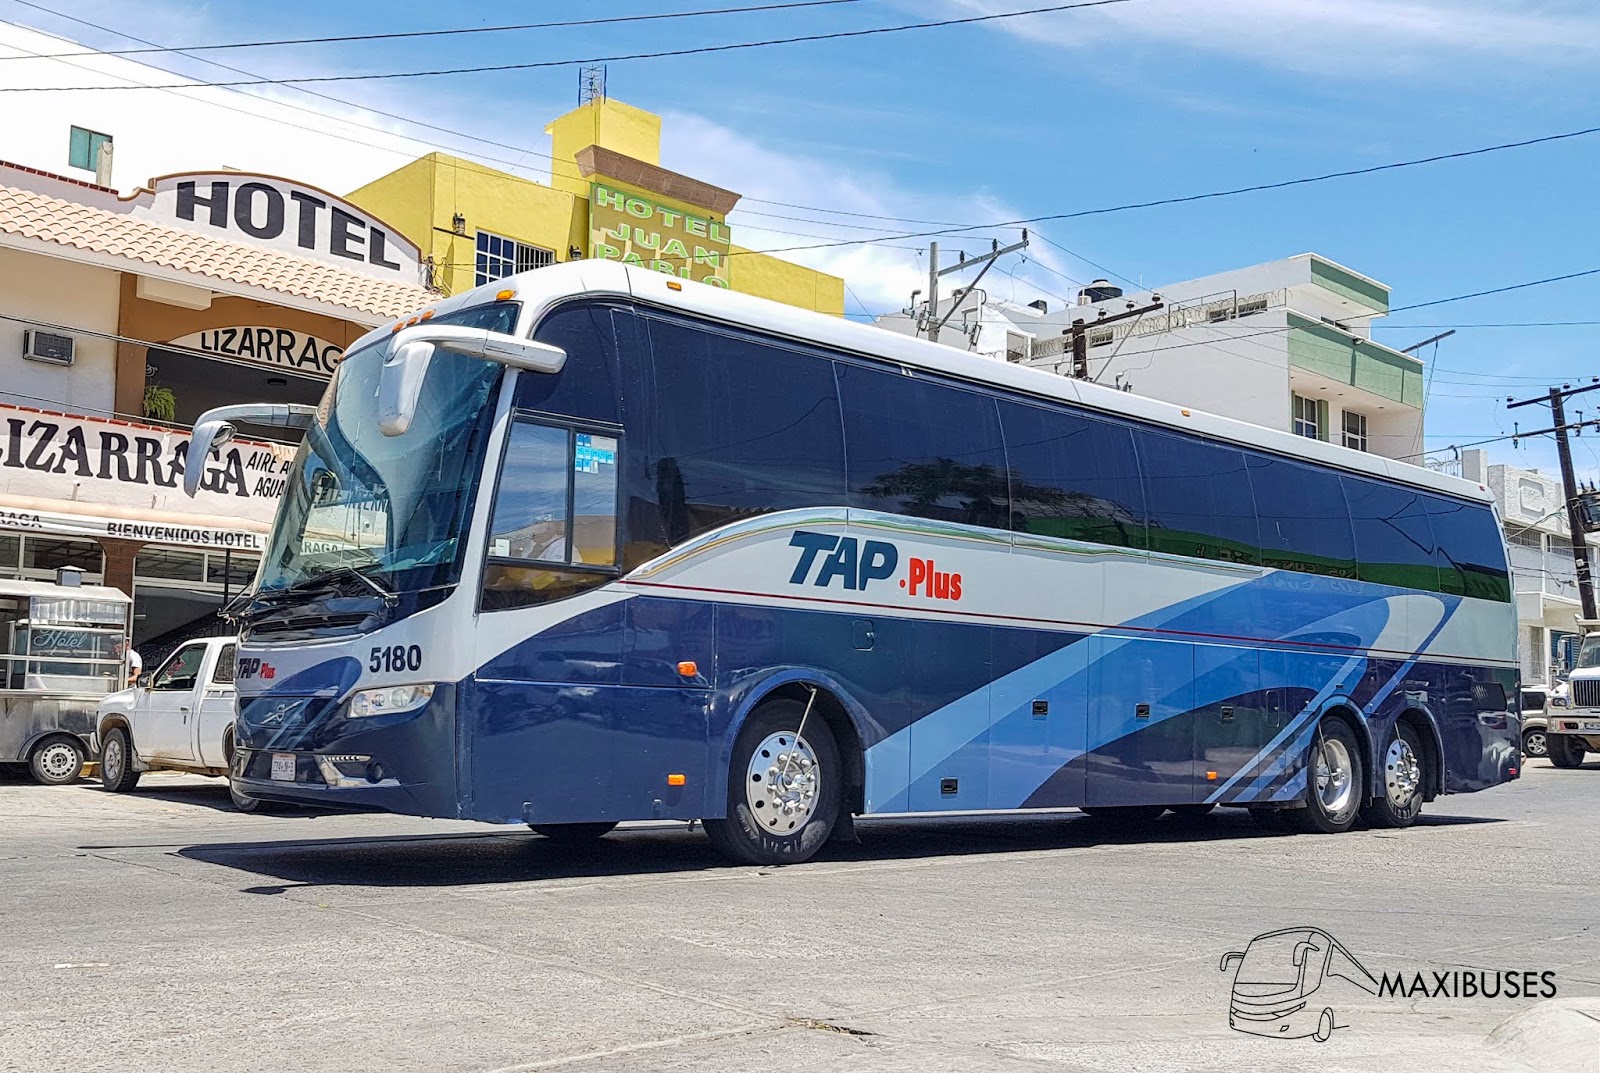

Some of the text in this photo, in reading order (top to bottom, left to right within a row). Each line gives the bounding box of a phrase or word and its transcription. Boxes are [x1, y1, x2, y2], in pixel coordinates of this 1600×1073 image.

[176, 181, 400, 271] HOTEL
[596, 187, 729, 244] HOTEL
[607, 222, 720, 268] JUAN
[0, 418, 250, 498] IZARRAGA
[245, 451, 278, 474] AIRE
[106, 522, 210, 544] BIENVENIDOS
[214, 531, 260, 549] HOTEL
[789, 530, 898, 591] TAP
[237, 657, 260, 679] TAP
[369, 645, 422, 673] 5180
